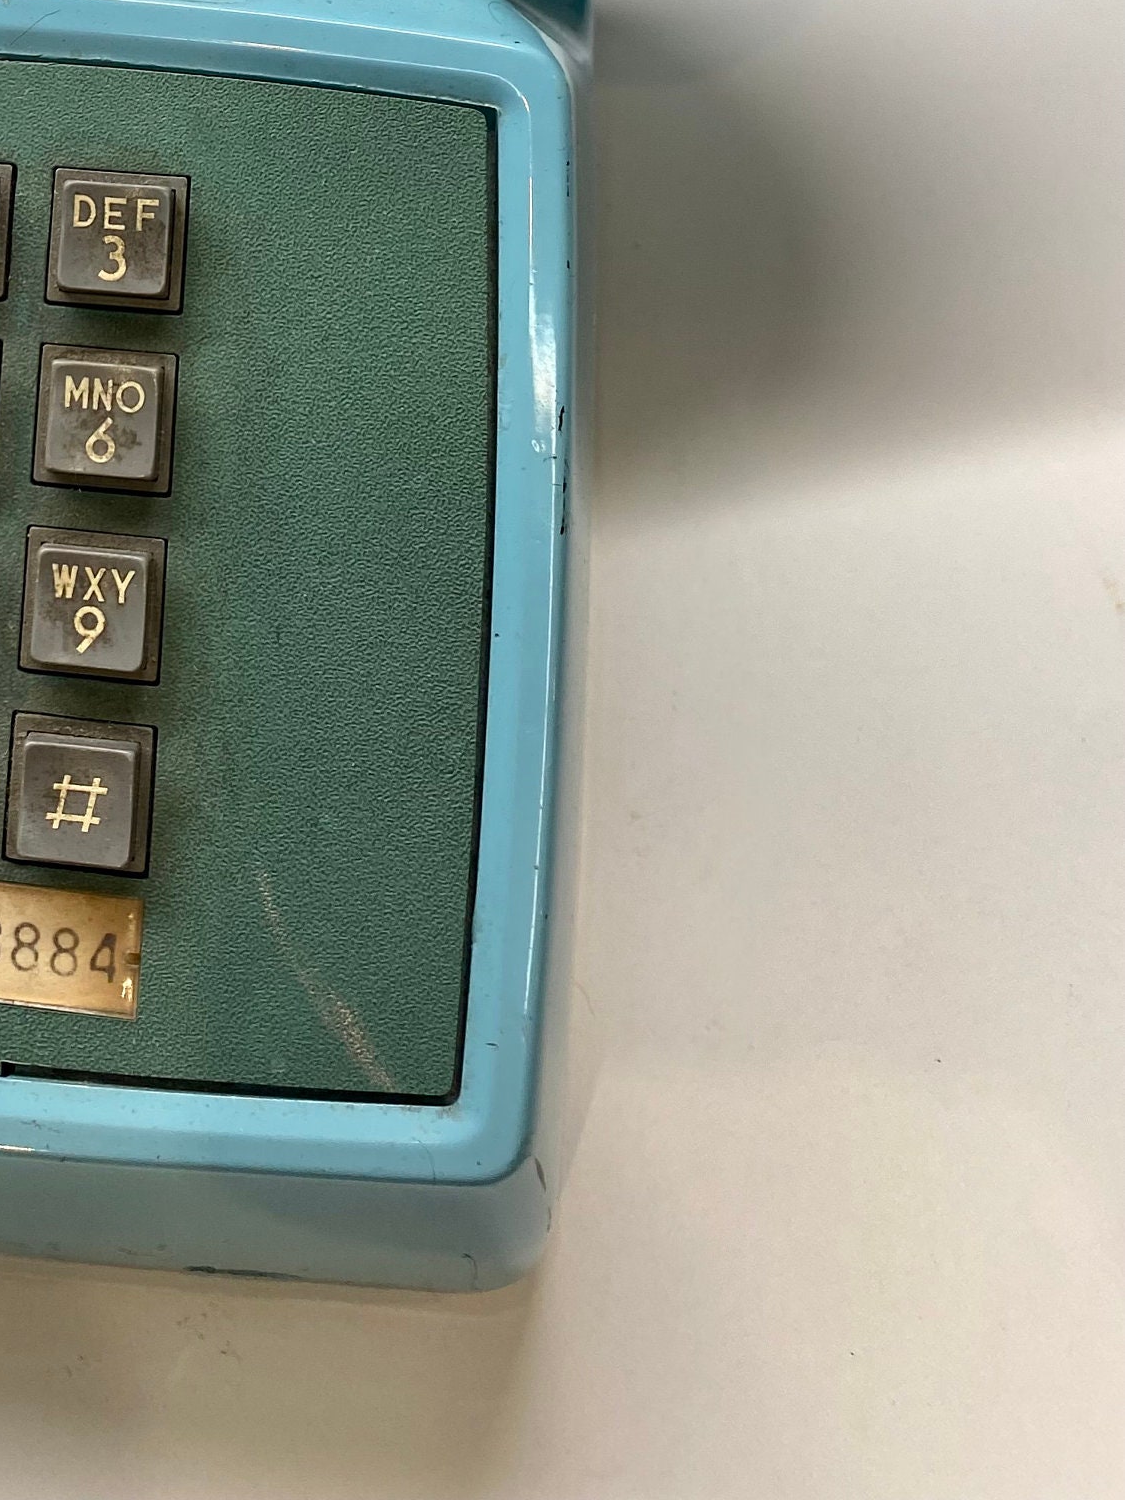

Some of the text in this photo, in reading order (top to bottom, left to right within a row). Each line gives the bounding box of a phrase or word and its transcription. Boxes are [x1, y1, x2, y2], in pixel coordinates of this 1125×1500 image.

[72, 194, 160, 232] DEF
[97, 235, 128, 282] 3
[64, 376, 145, 414] MNO
[85, 416, 117, 464] 6
[51, 563, 136, 604] WXY
[73, 606, 106, 654] 9
